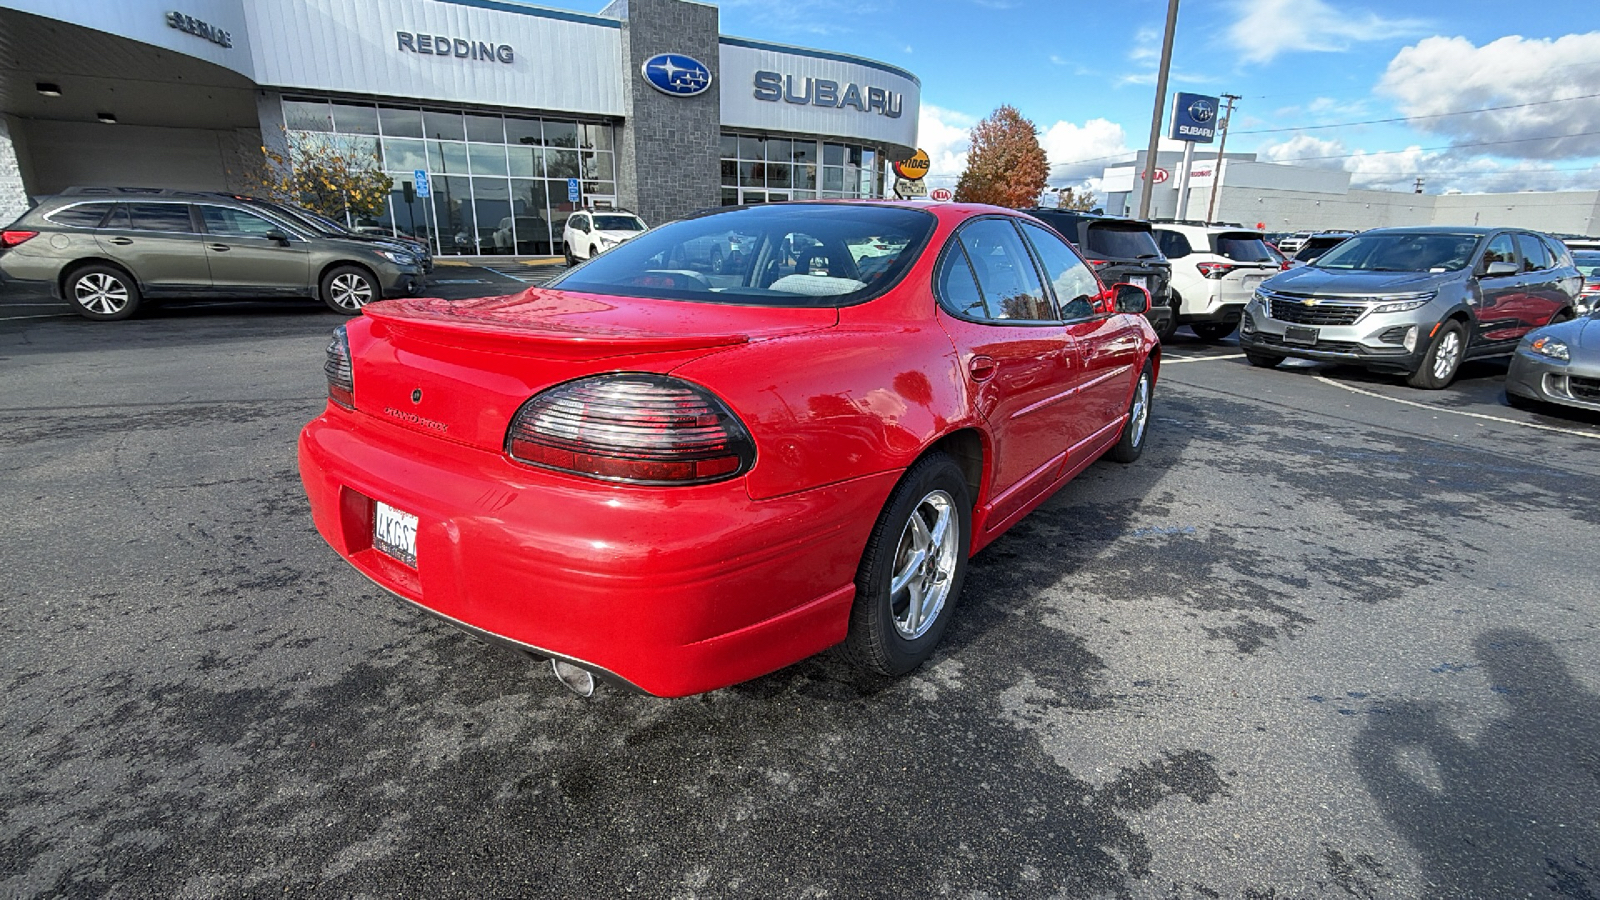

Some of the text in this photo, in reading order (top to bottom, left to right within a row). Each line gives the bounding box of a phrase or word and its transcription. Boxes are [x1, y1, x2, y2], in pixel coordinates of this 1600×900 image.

[396, 31, 514, 63] REDDING
[754, 70, 903, 119] SUBARU
[1179, 125, 1214, 138] SUBARU
[900, 159, 929, 169] MIDAS
[935, 191, 949, 200] KIA
